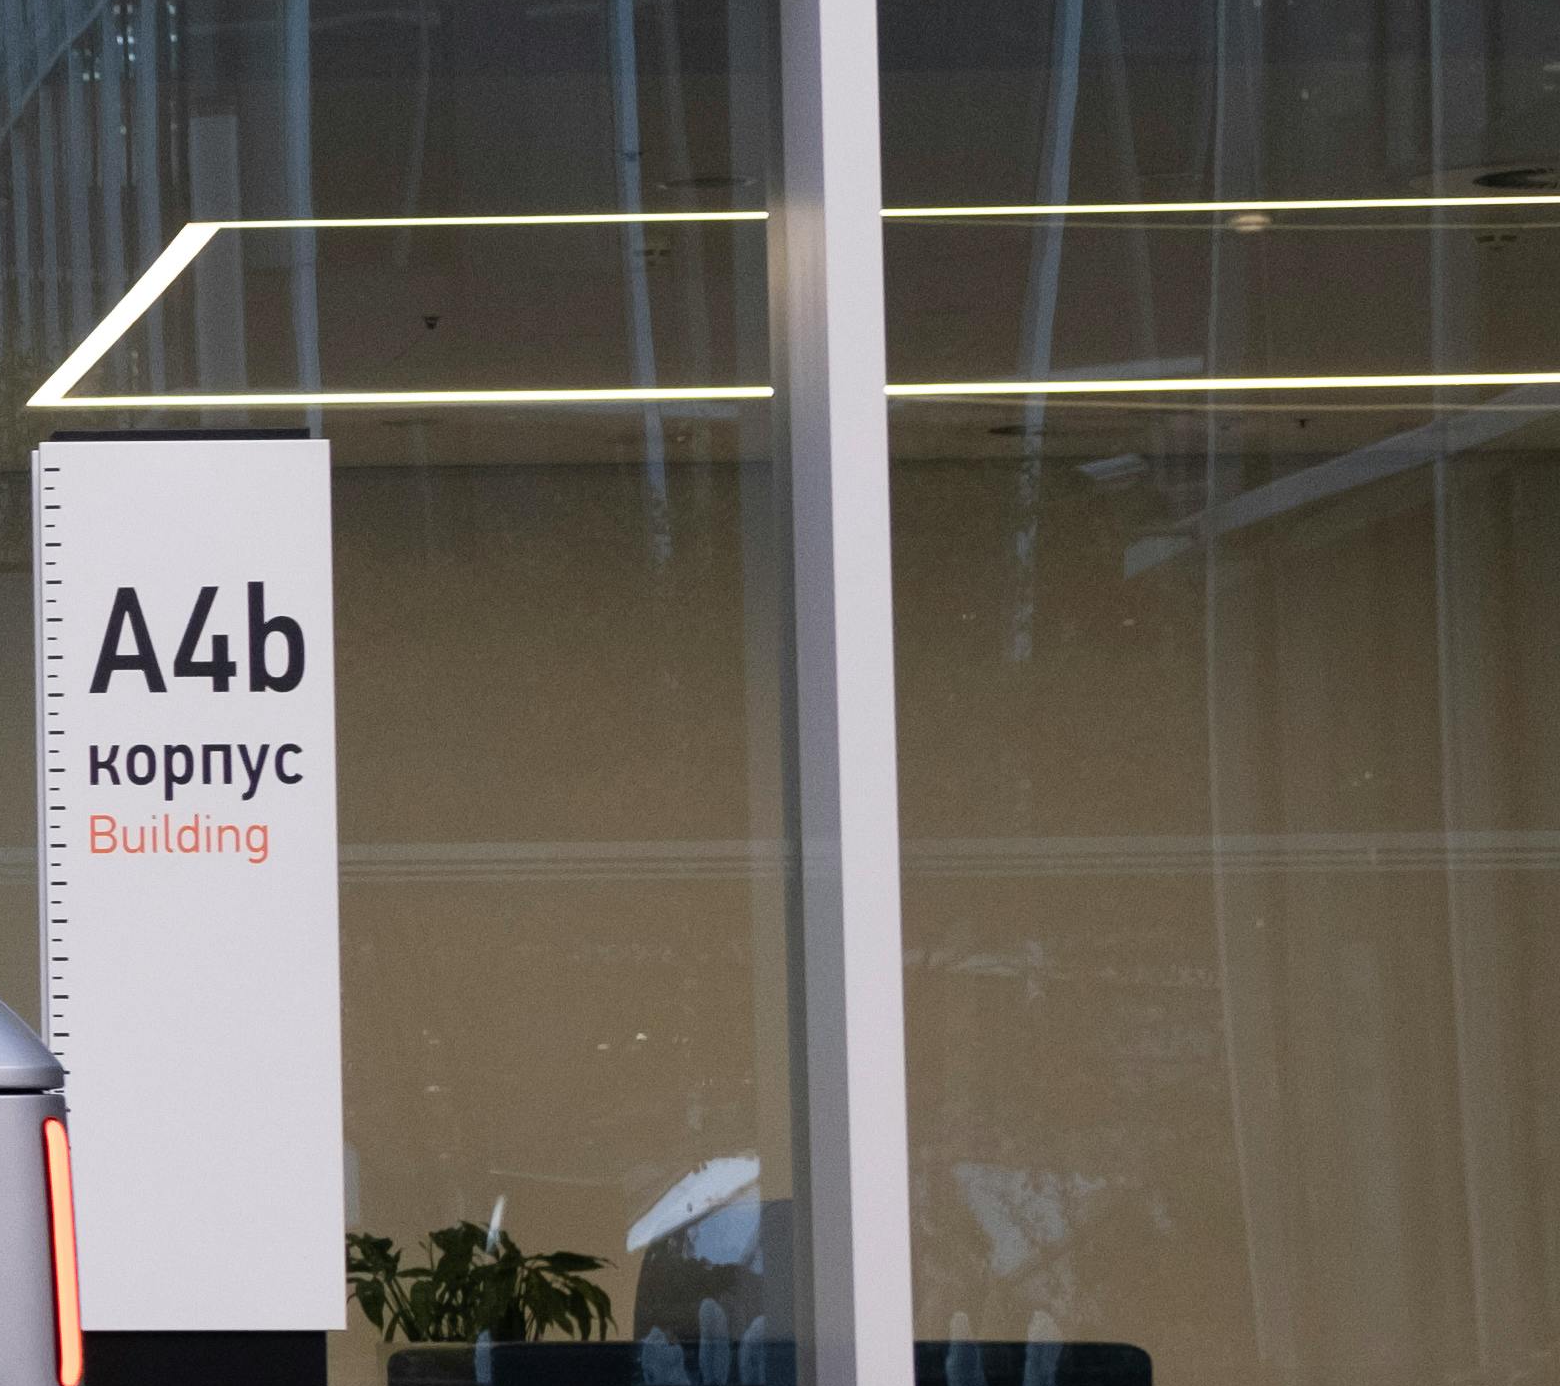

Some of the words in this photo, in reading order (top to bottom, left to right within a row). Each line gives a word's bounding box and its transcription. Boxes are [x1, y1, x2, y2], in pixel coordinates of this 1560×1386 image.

[89, 581, 305, 693] A4b
[89, 743, 304, 801] корпус
[90, 813, 269, 864] Building
